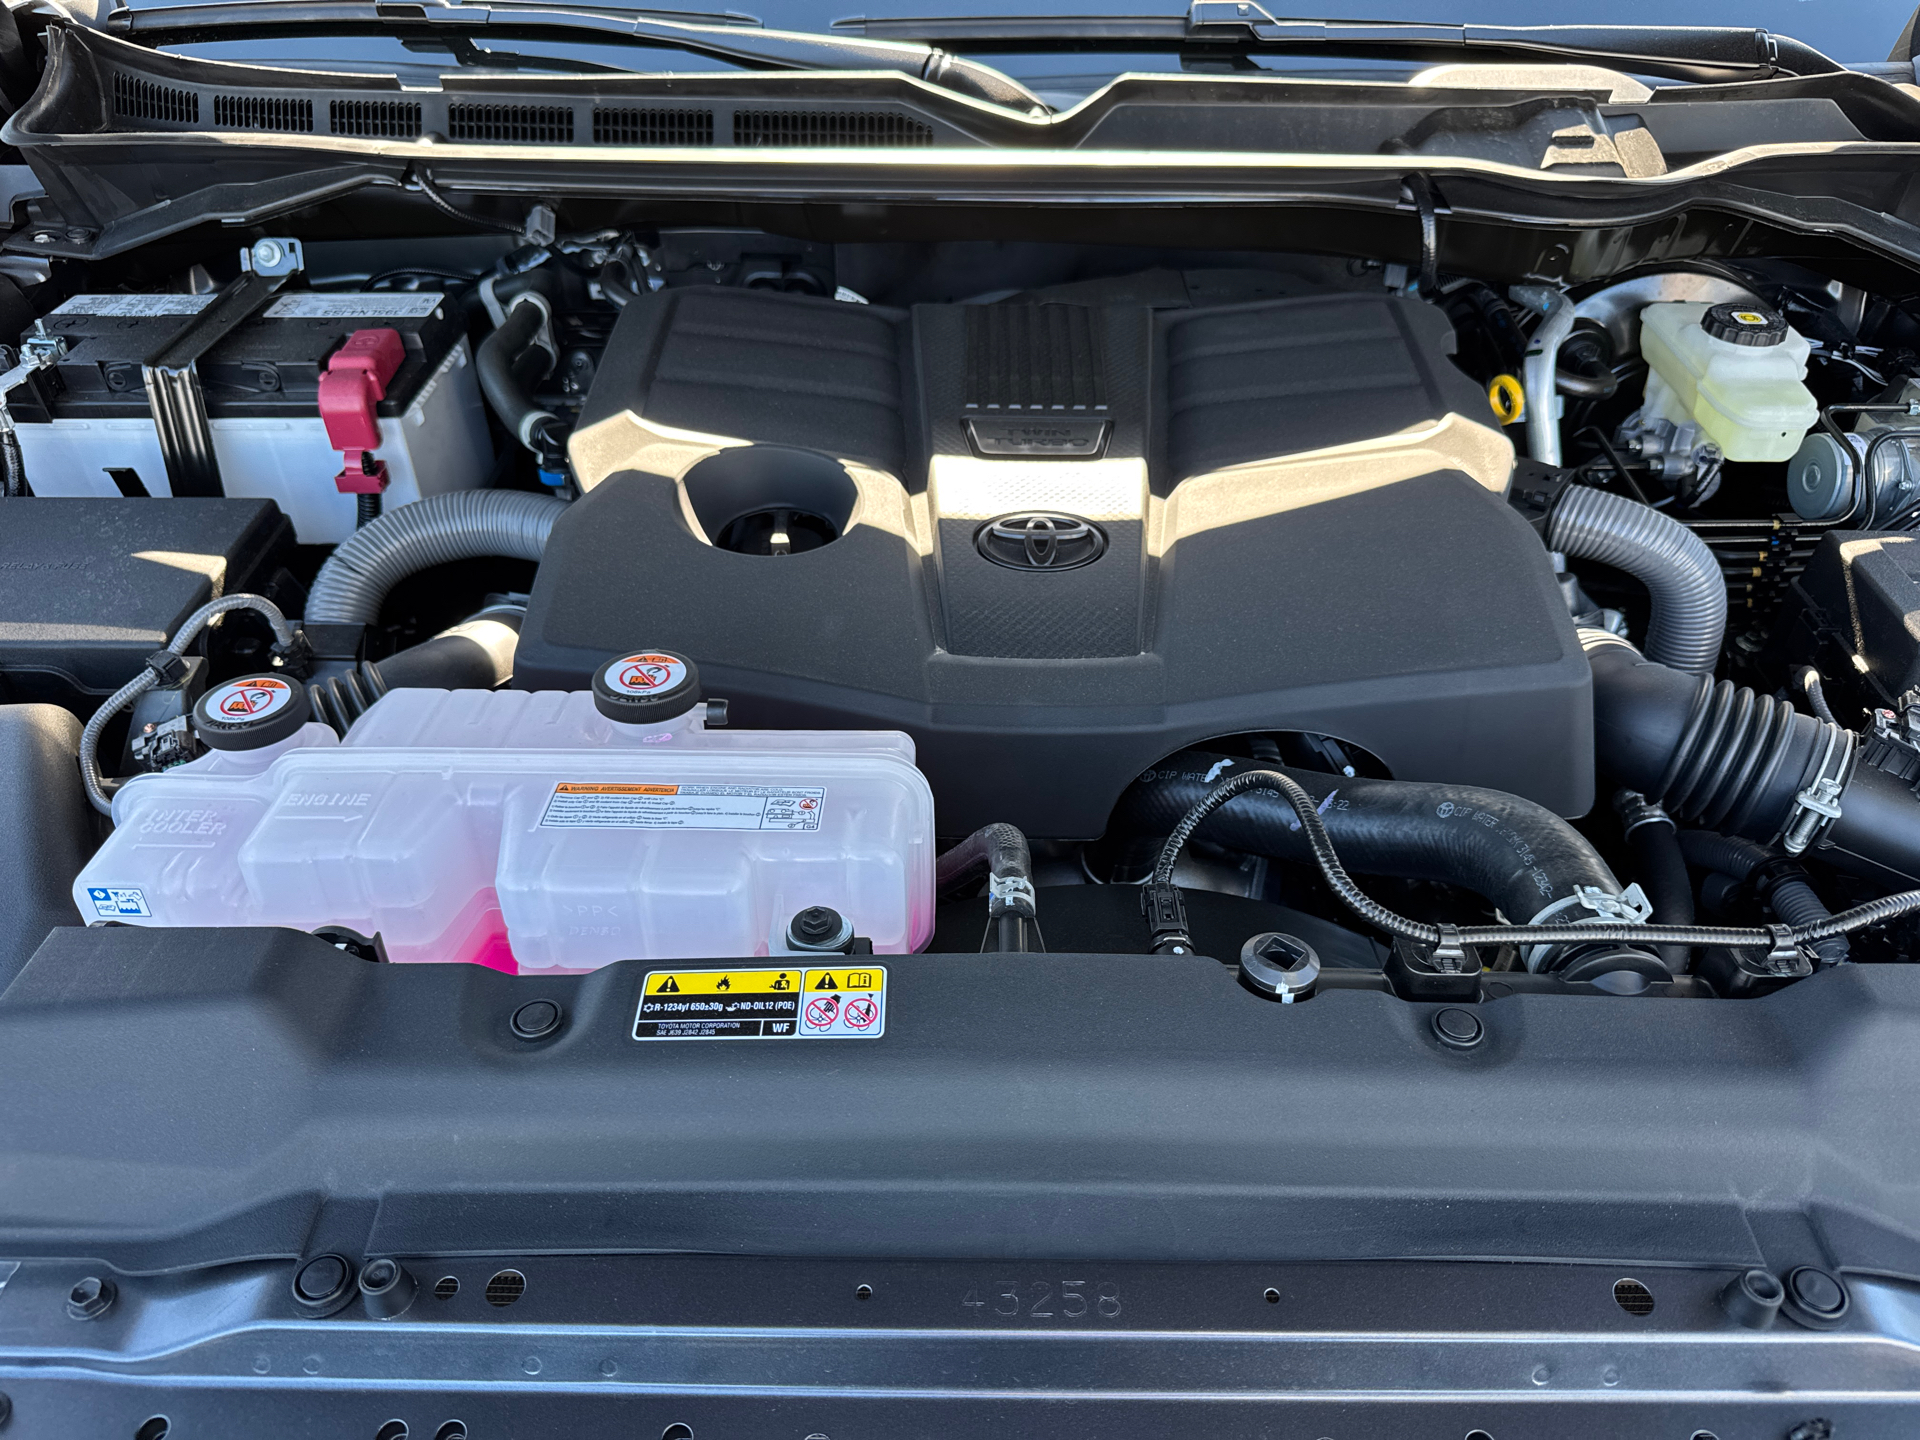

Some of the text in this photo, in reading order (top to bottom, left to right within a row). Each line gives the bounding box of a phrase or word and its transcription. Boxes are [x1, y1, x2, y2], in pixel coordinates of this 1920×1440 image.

[999, 428, 1071, 437] TWIN
[986, 437, 1090, 447] TURBO
[1181, 771, 1209, 783] WATE
[282, 793, 372, 806] ENGINE
[146, 809, 217, 822] INTER
[139, 821, 227, 835] COOLER
[654, 1002, 690, 1013] R-1234yf
[690, 1002, 724, 1012] 650±30g
[775, 1001, 795, 1011] (POE)
[772, 1022, 790, 1033] WF
[962, 1280, 1122, 1318] 43258
